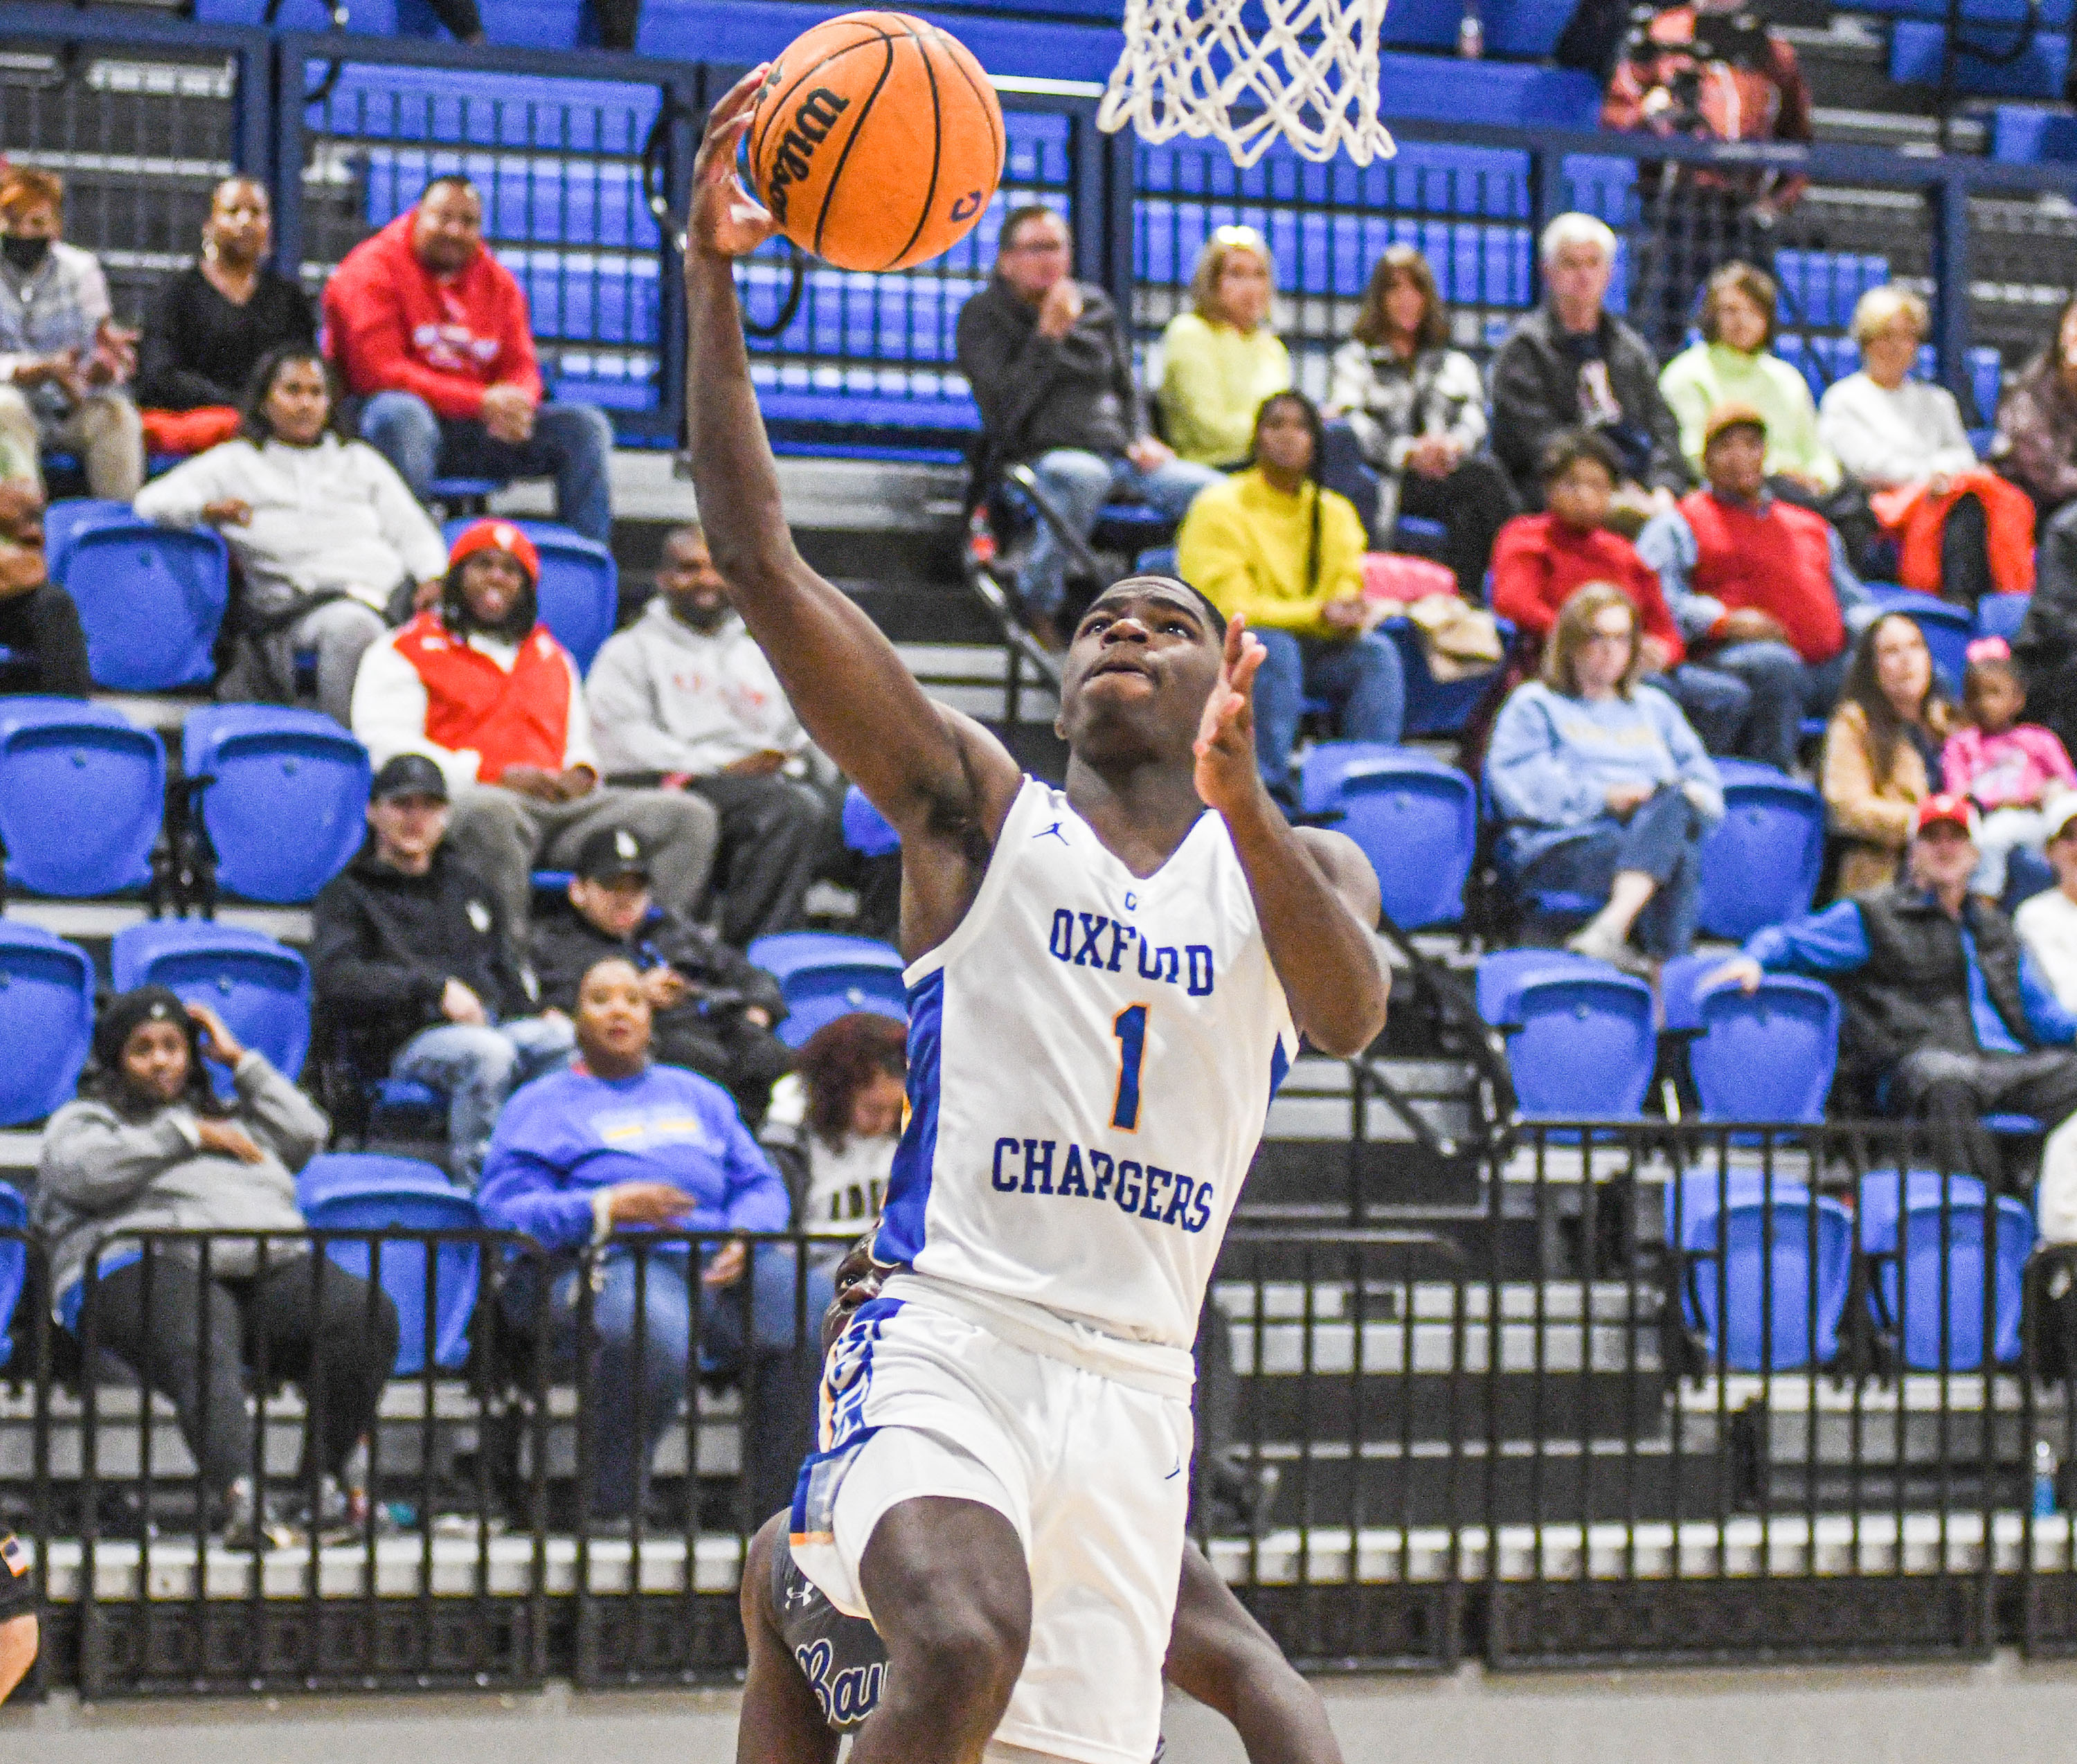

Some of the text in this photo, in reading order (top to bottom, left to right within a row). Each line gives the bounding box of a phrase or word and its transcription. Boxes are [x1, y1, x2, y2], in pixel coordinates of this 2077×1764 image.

[1124, 891, 1138, 911] C
[1108, 1001, 1152, 1135] 1
[991, 1137, 1213, 1233] CHARGERS
